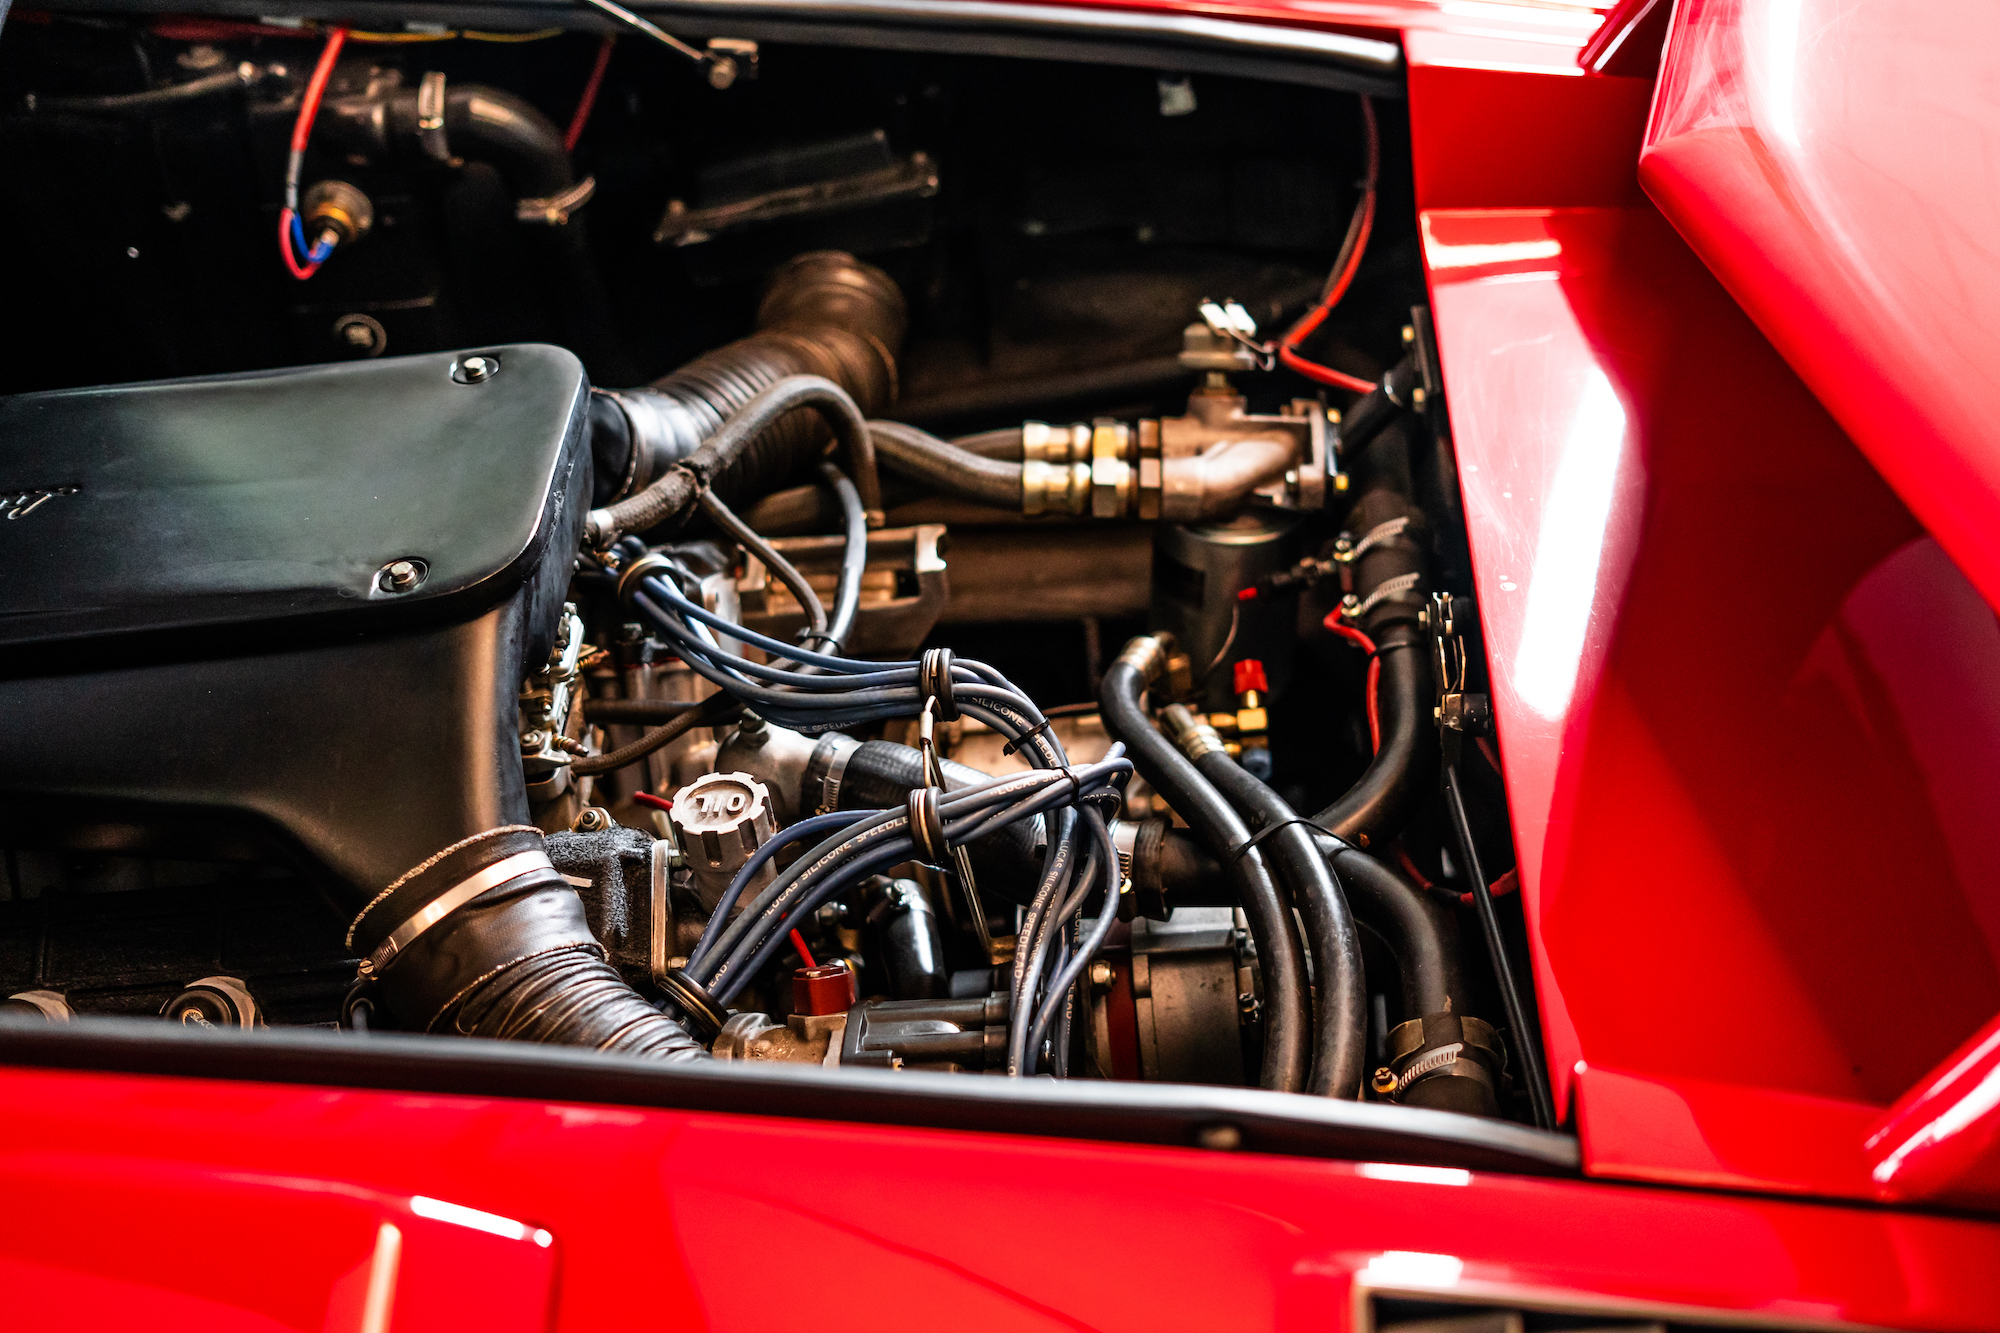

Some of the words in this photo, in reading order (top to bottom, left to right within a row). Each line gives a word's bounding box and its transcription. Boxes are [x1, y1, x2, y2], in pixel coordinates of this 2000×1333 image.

[972, 697, 1025, 727] SILICONE
[800, 842, 852, 881] SILICONE
[1032, 870, 1059, 909] SILICONE
